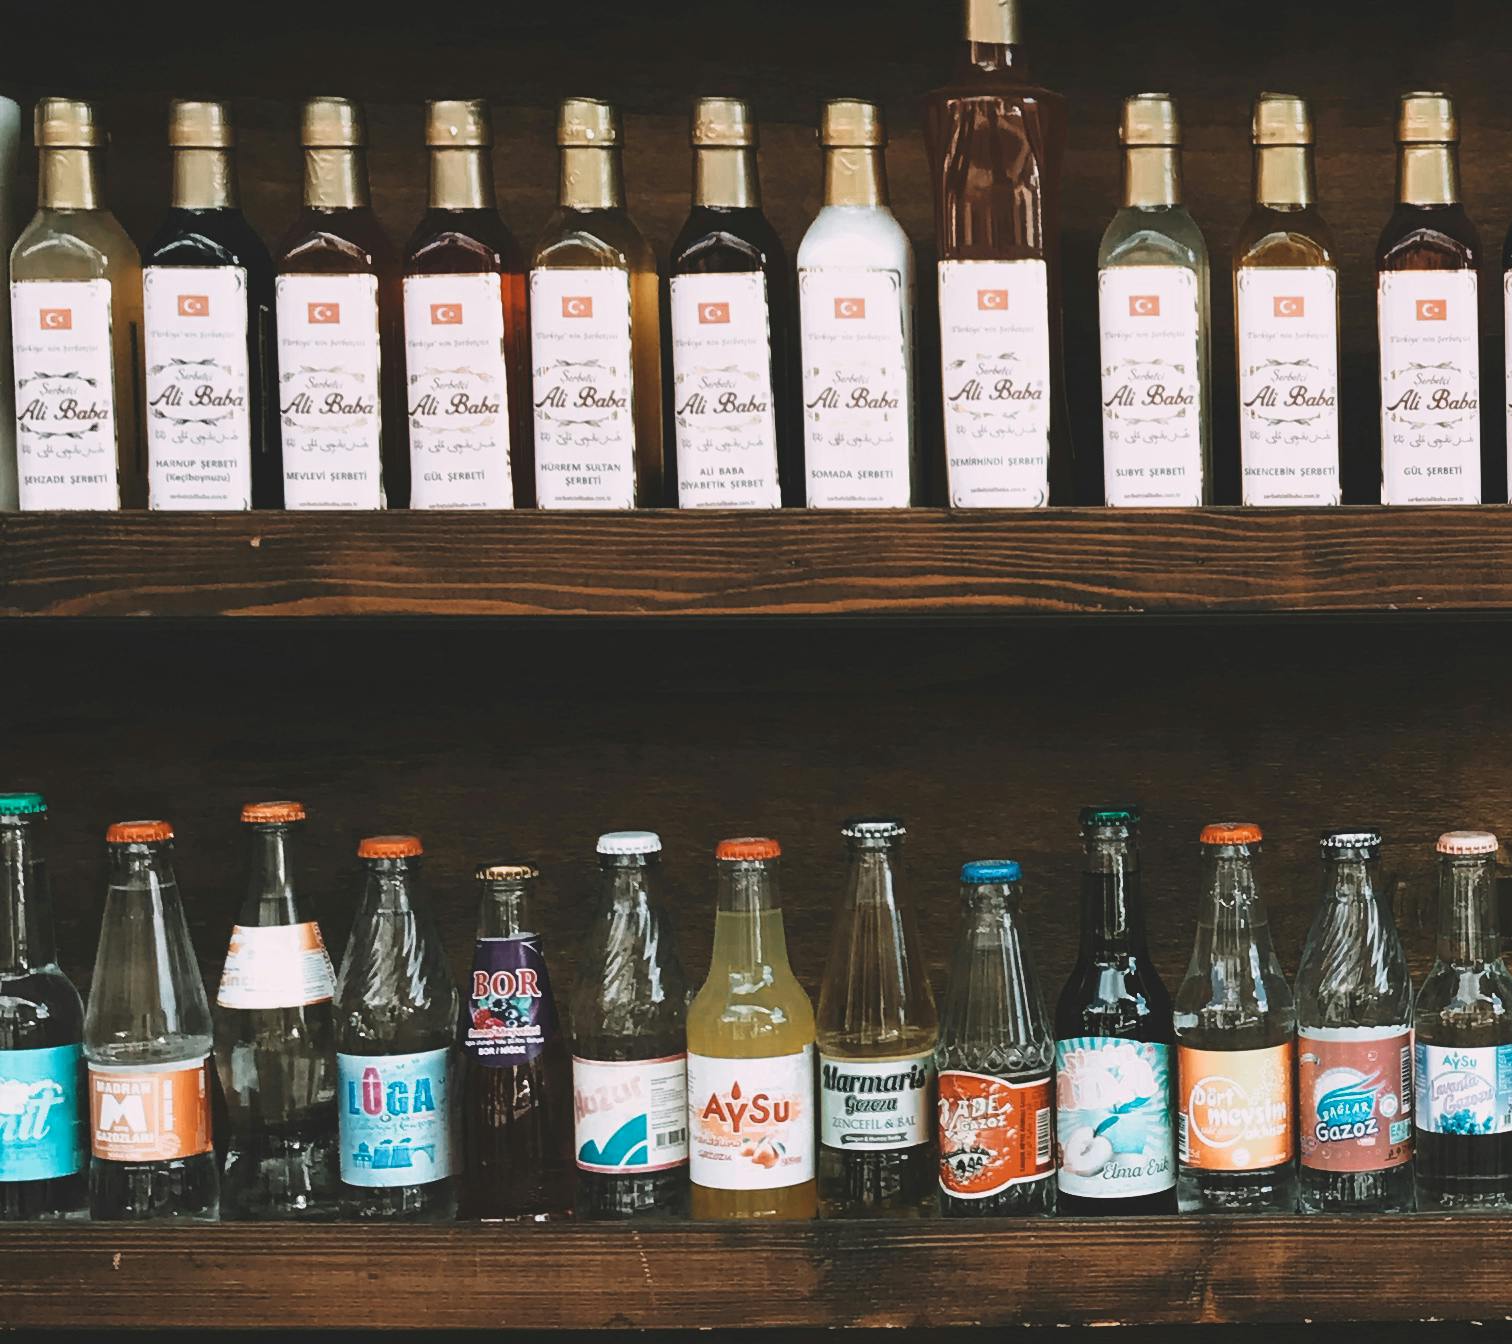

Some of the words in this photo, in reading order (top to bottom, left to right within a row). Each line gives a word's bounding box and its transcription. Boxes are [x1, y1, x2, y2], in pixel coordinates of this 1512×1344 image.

[149, 385, 182, 410] Ali
[189, 385, 244, 410] Baba
[806, 387, 840, 408] Ali
[845, 387, 898, 408] Baba
[948, 379, 982, 401] Ali
[989, 379, 1042, 400] Baba
[1386, 389, 1421, 412] Ali
[1427, 389, 1477, 410] Baba
[16, 397, 48, 422] Ali
[54, 398, 108, 422] Baba
[407, 392, 439, 417] Ali
[445, 393, 499, 415] Baba
[676, 391, 707, 416] Ali
[713, 392, 766, 414] Baba
[448, 471, 484, 482] ŞERBETİ
[1404, 466, 1422, 475] GÜL
[1427, 466, 1462, 477] ŞERBETİ
[472, 969, 543, 1000] BOR
[823, 1060, 927, 1102] Marmaris
[844, 1094, 900, 1119] Gazozu
[1323, 1102, 1371, 1124] BAĞLAR
[832, 1117, 880, 1132] ZENCEFİL
[884, 1117, 894, 1131] &
[897, 1114, 916, 1129] BAL
[960, 1115, 1007, 1132] GAZOZ
[1104, 1163, 1145, 1180] Elma
[1147, 1157, 1170, 1176] Erik
